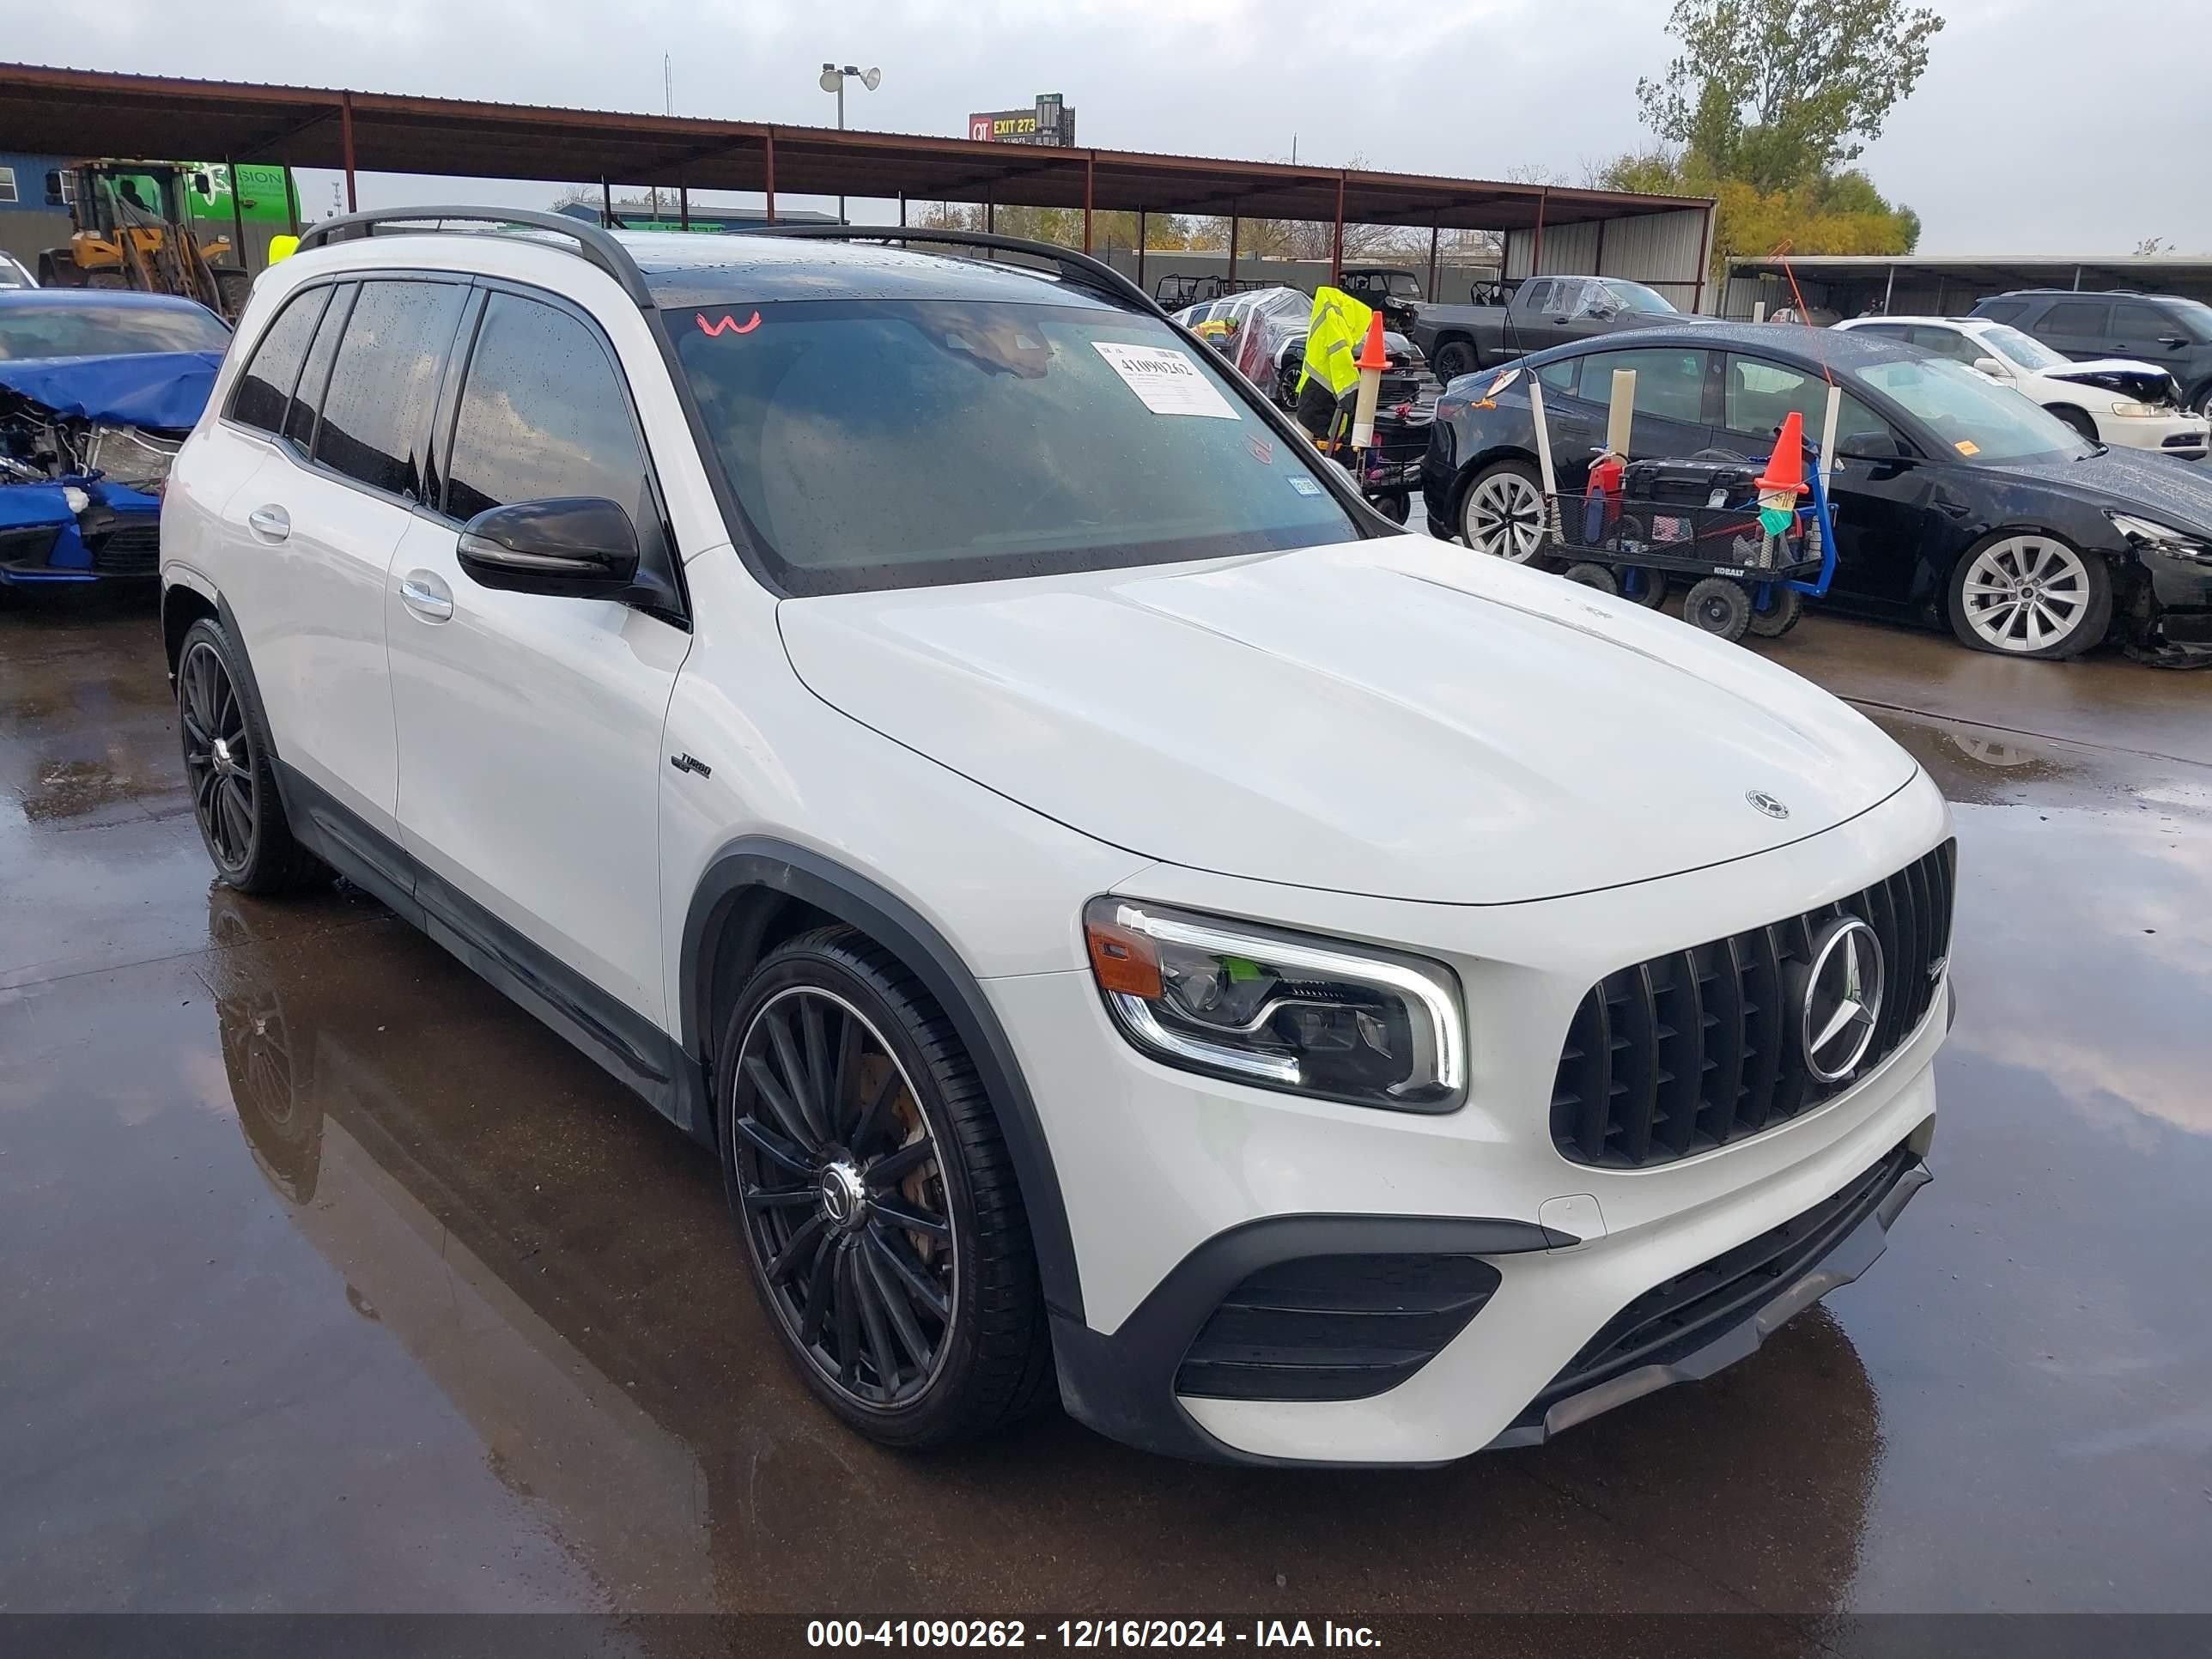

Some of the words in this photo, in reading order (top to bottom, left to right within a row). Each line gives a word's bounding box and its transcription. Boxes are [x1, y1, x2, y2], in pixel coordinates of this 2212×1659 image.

[973, 123, 988, 141] QT
[994, 120, 1016, 135] EXIT
[1018, 118, 1036, 133] 273
[1121, 358, 1194, 376] 41090262
[1714, 566, 1745, 577] KOBALT
[682, 751, 712, 776] TURBO
